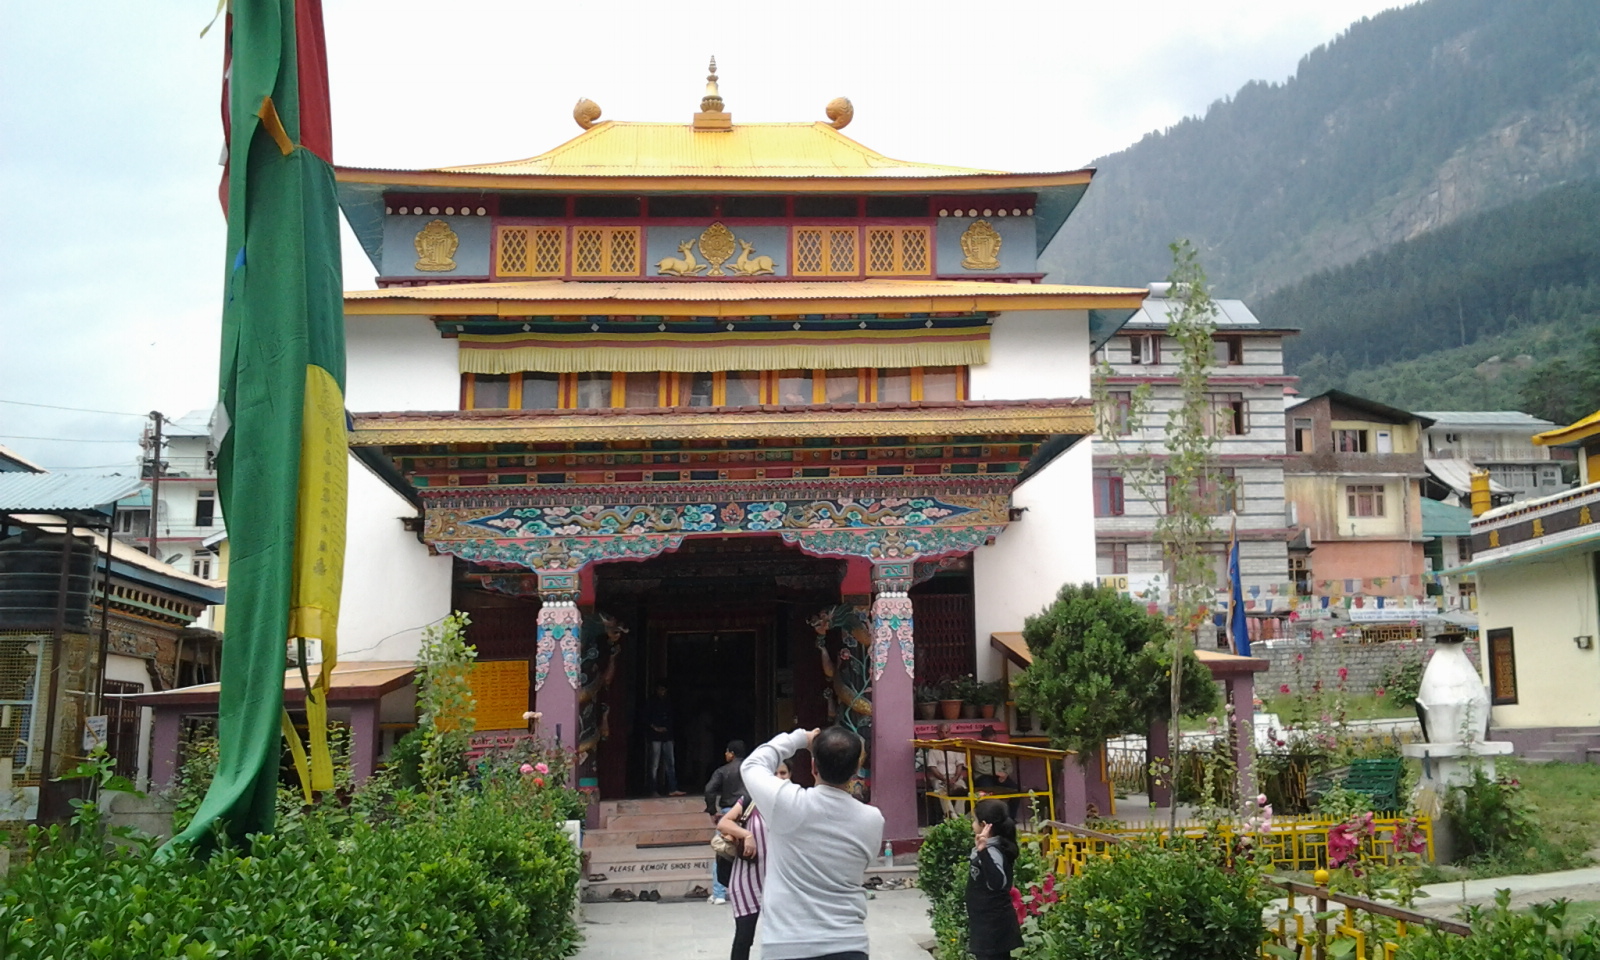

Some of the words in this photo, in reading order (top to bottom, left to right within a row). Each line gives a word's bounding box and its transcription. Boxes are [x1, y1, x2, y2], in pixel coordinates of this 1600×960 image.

[609, 865, 636, 873] PLEASE
[640, 863, 668, 873] REMOVE
[670, 862, 691, 870] SHOES
[693, 861, 710, 869] HERE
